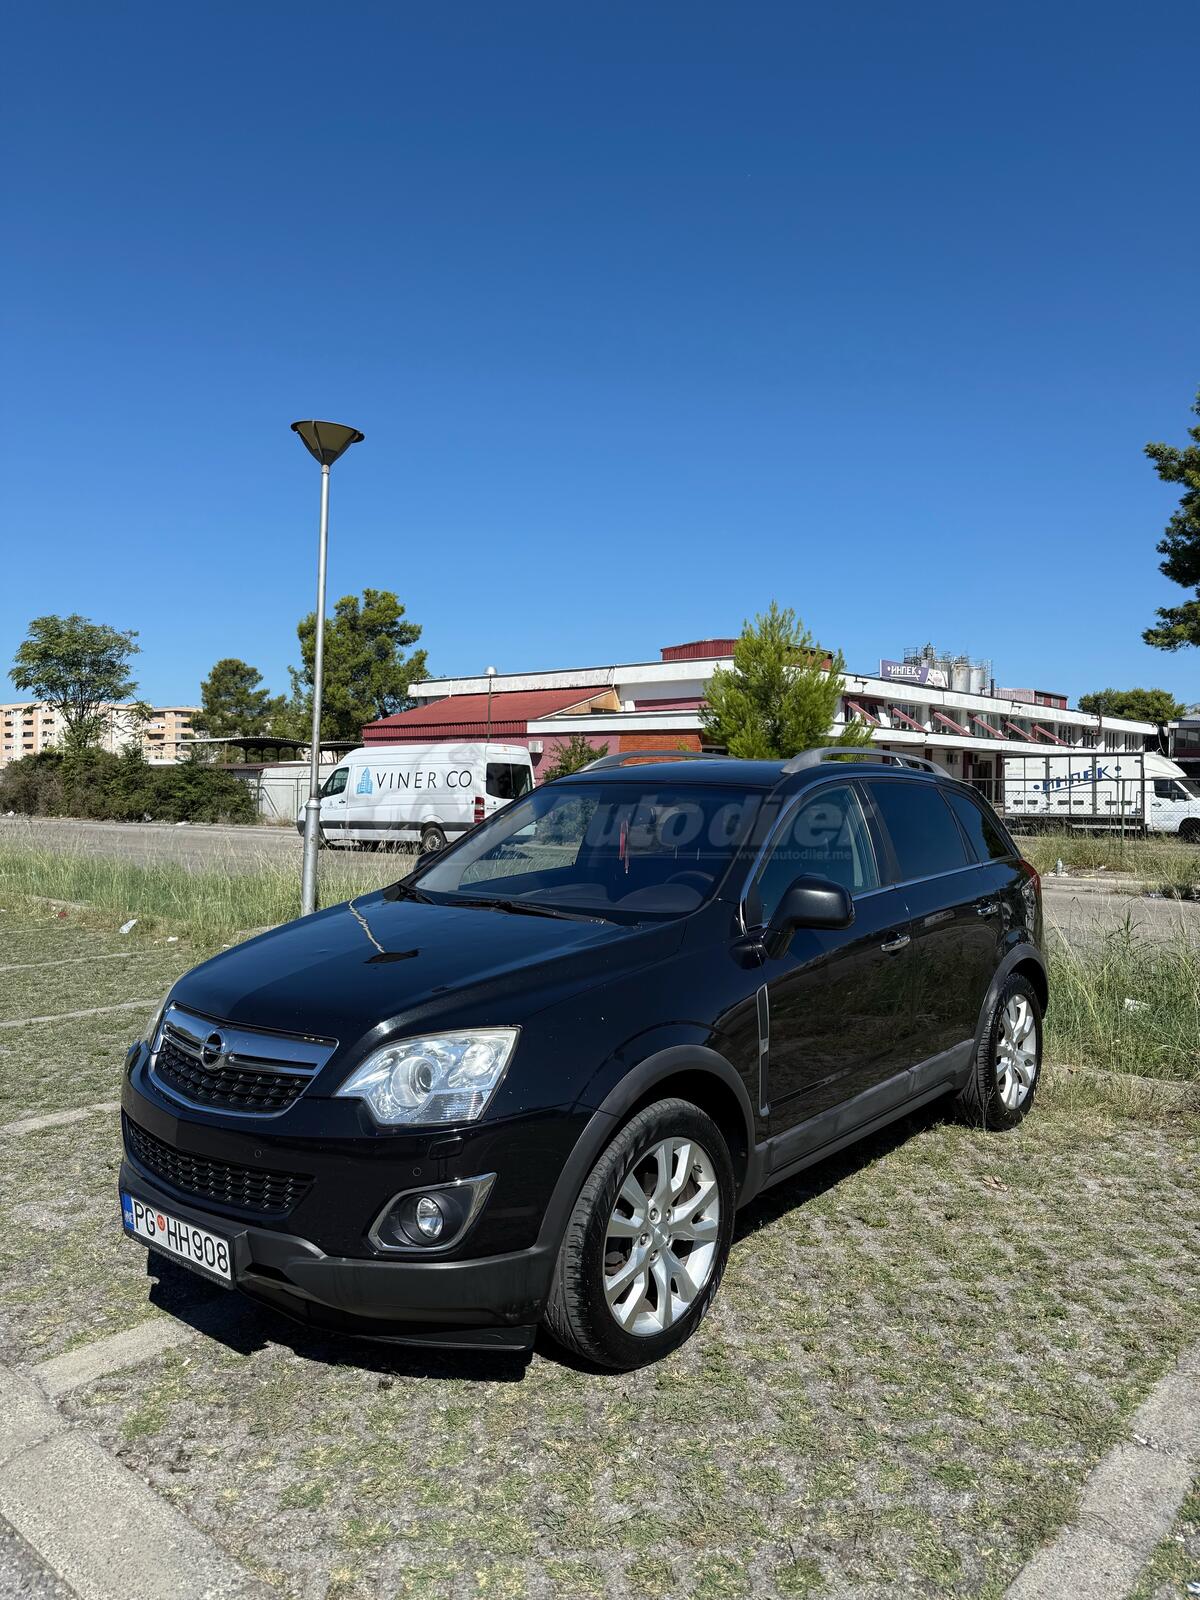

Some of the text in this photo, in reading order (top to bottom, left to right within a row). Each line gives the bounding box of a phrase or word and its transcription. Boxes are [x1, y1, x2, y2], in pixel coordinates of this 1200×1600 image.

[376, 769, 473, 790] VINER CO
[134, 1201, 156, 1236] PG
[166, 1217, 229, 1273] HH908
